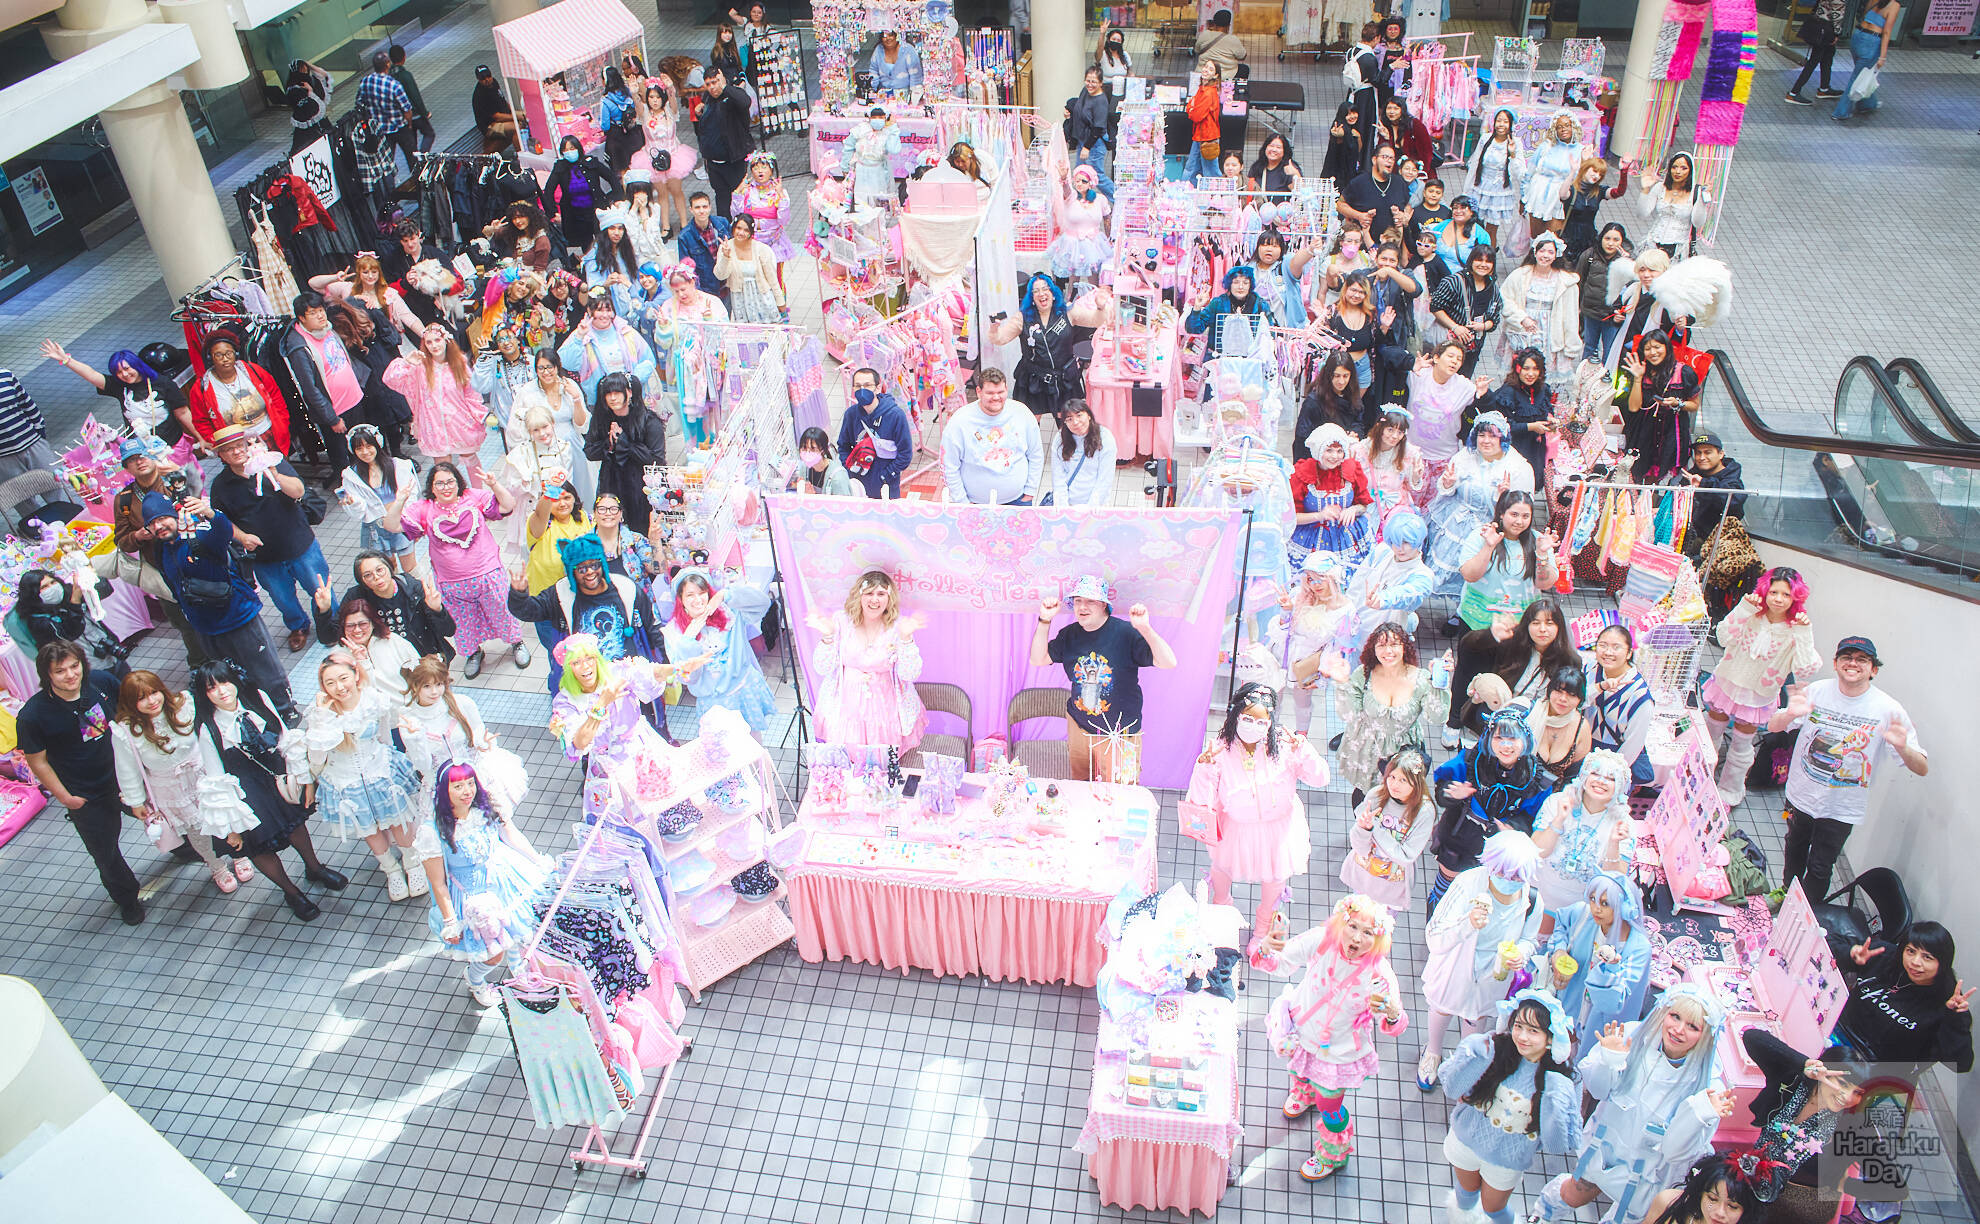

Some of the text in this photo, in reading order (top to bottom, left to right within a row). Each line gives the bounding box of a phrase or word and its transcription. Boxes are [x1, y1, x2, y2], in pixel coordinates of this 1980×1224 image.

[894, 568, 1118, 609] Holley Tea Te
